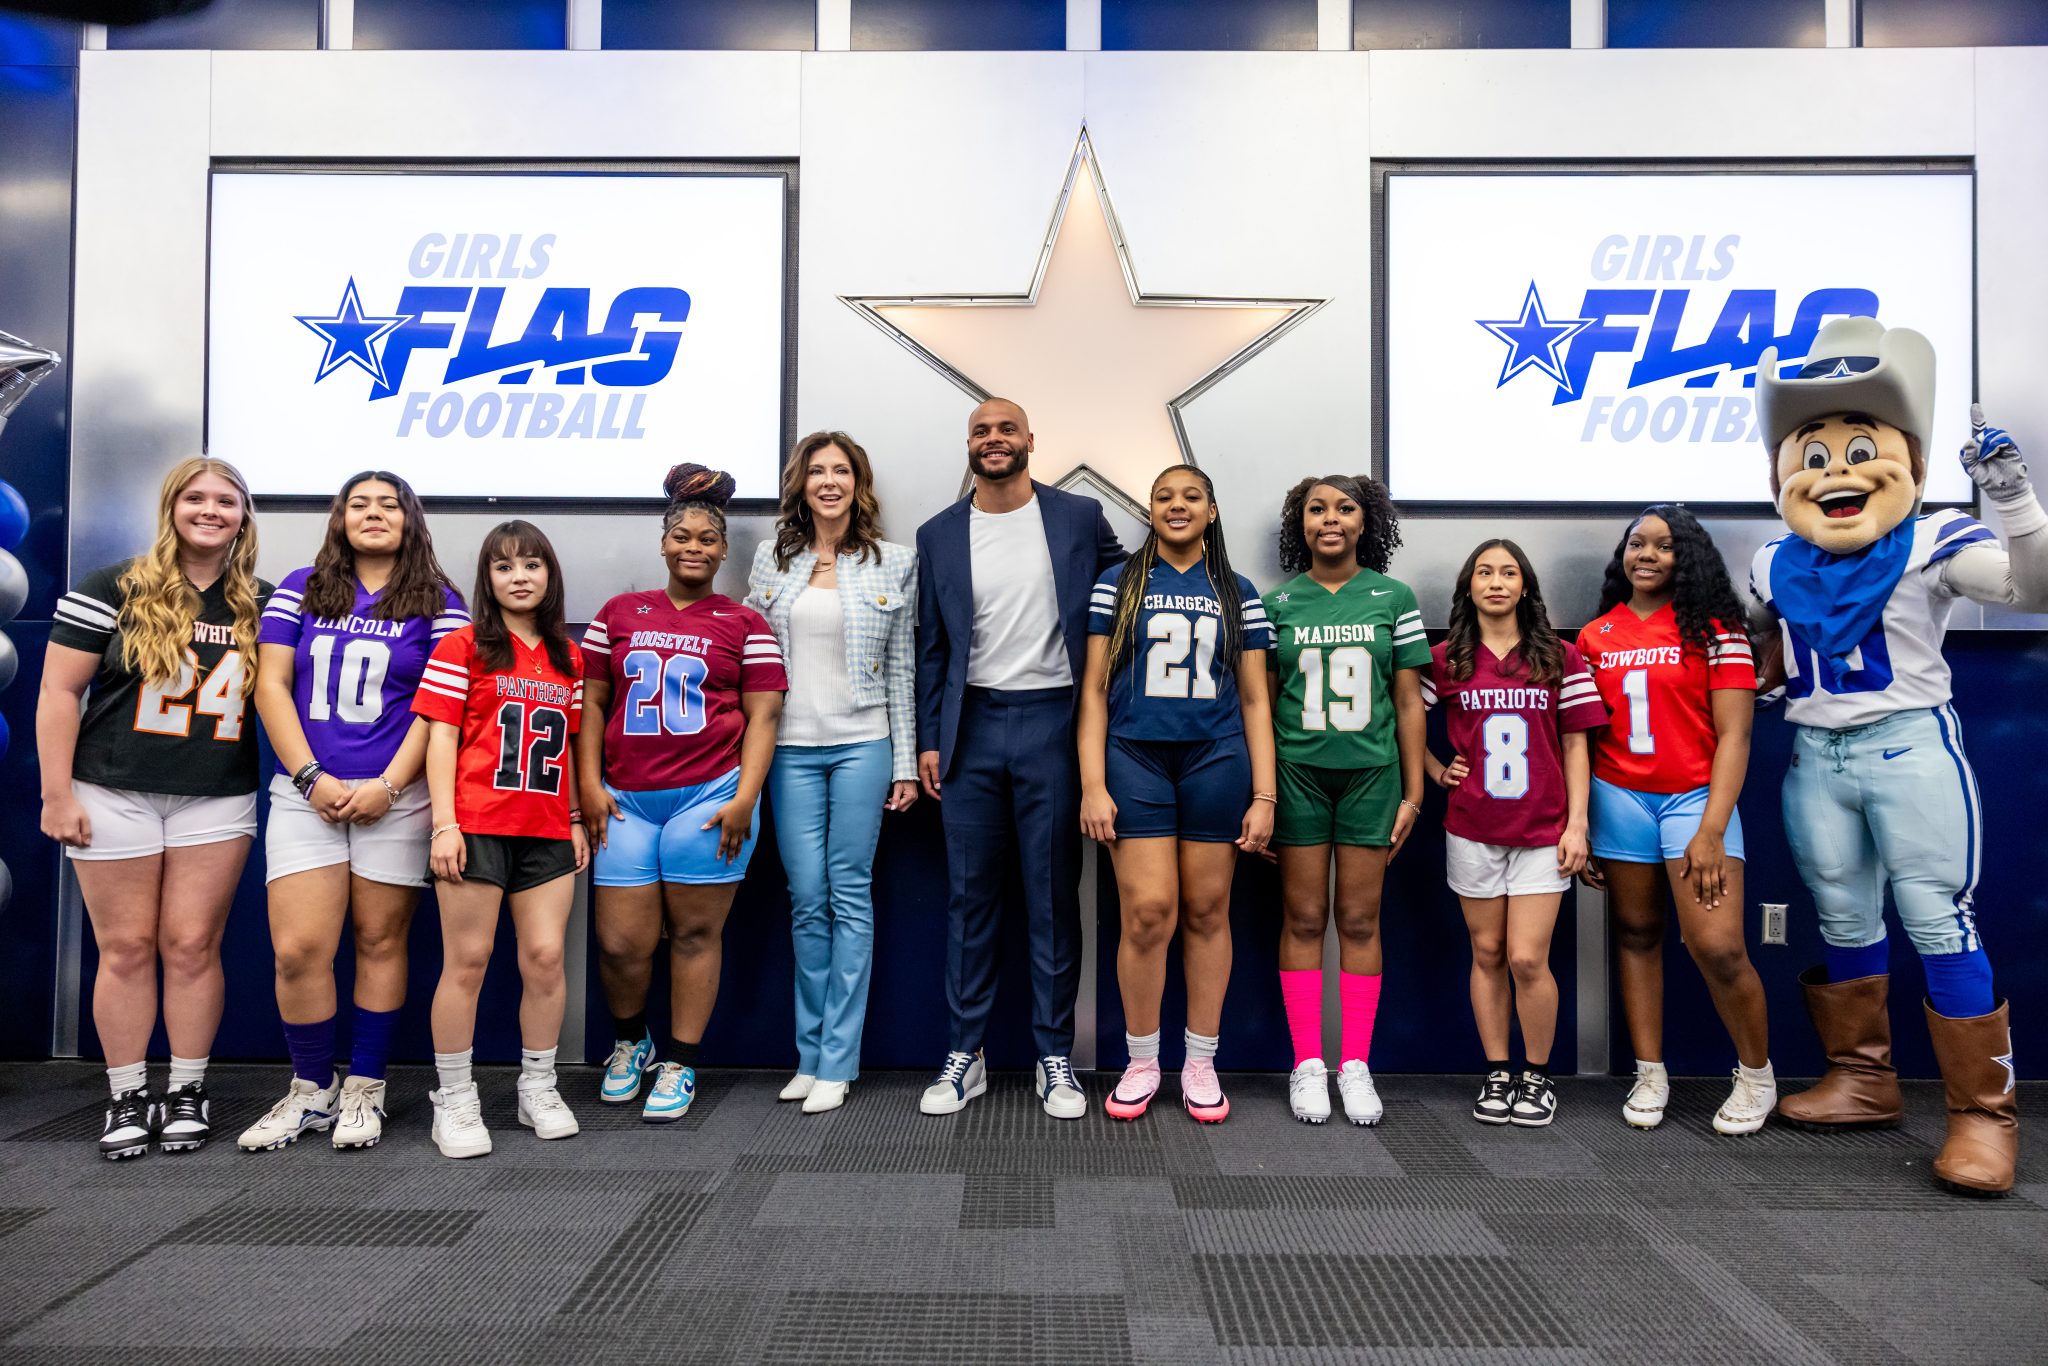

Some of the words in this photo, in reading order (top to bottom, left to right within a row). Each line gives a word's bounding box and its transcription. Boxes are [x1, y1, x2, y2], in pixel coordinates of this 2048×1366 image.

[408, 232, 557, 280] GIRLS
[1590, 234, 1741, 281] GIRLS
[369, 286, 691, 401] FLAG
[396, 391, 647, 439] FOOTBALL
[1580, 395, 1761, 443] FOOTB
[313, 614, 405, 638] LINCOLN
[1144, 594, 1221, 616] CHARGERS
[193, 621, 236, 646] WHIT
[629, 631, 712, 655] ROOSEVELT
[1144, 612, 1218, 699] 21
[1294, 624, 1375, 646] MADISON
[1600, 646, 1680, 669] COWBOYS
[133, 643, 247, 741] 24
[309, 634, 392, 725] 10
[496, 675, 570, 706] PANTHERS
[623, 650, 710, 736] 20
[1299, 646, 1373, 731] 19
[1459, 688, 1549, 711] PATRIOTS
[1622, 669, 1655, 754] 1
[493, 700, 568, 796] 12
[1483, 713, 1529, 799] 8
